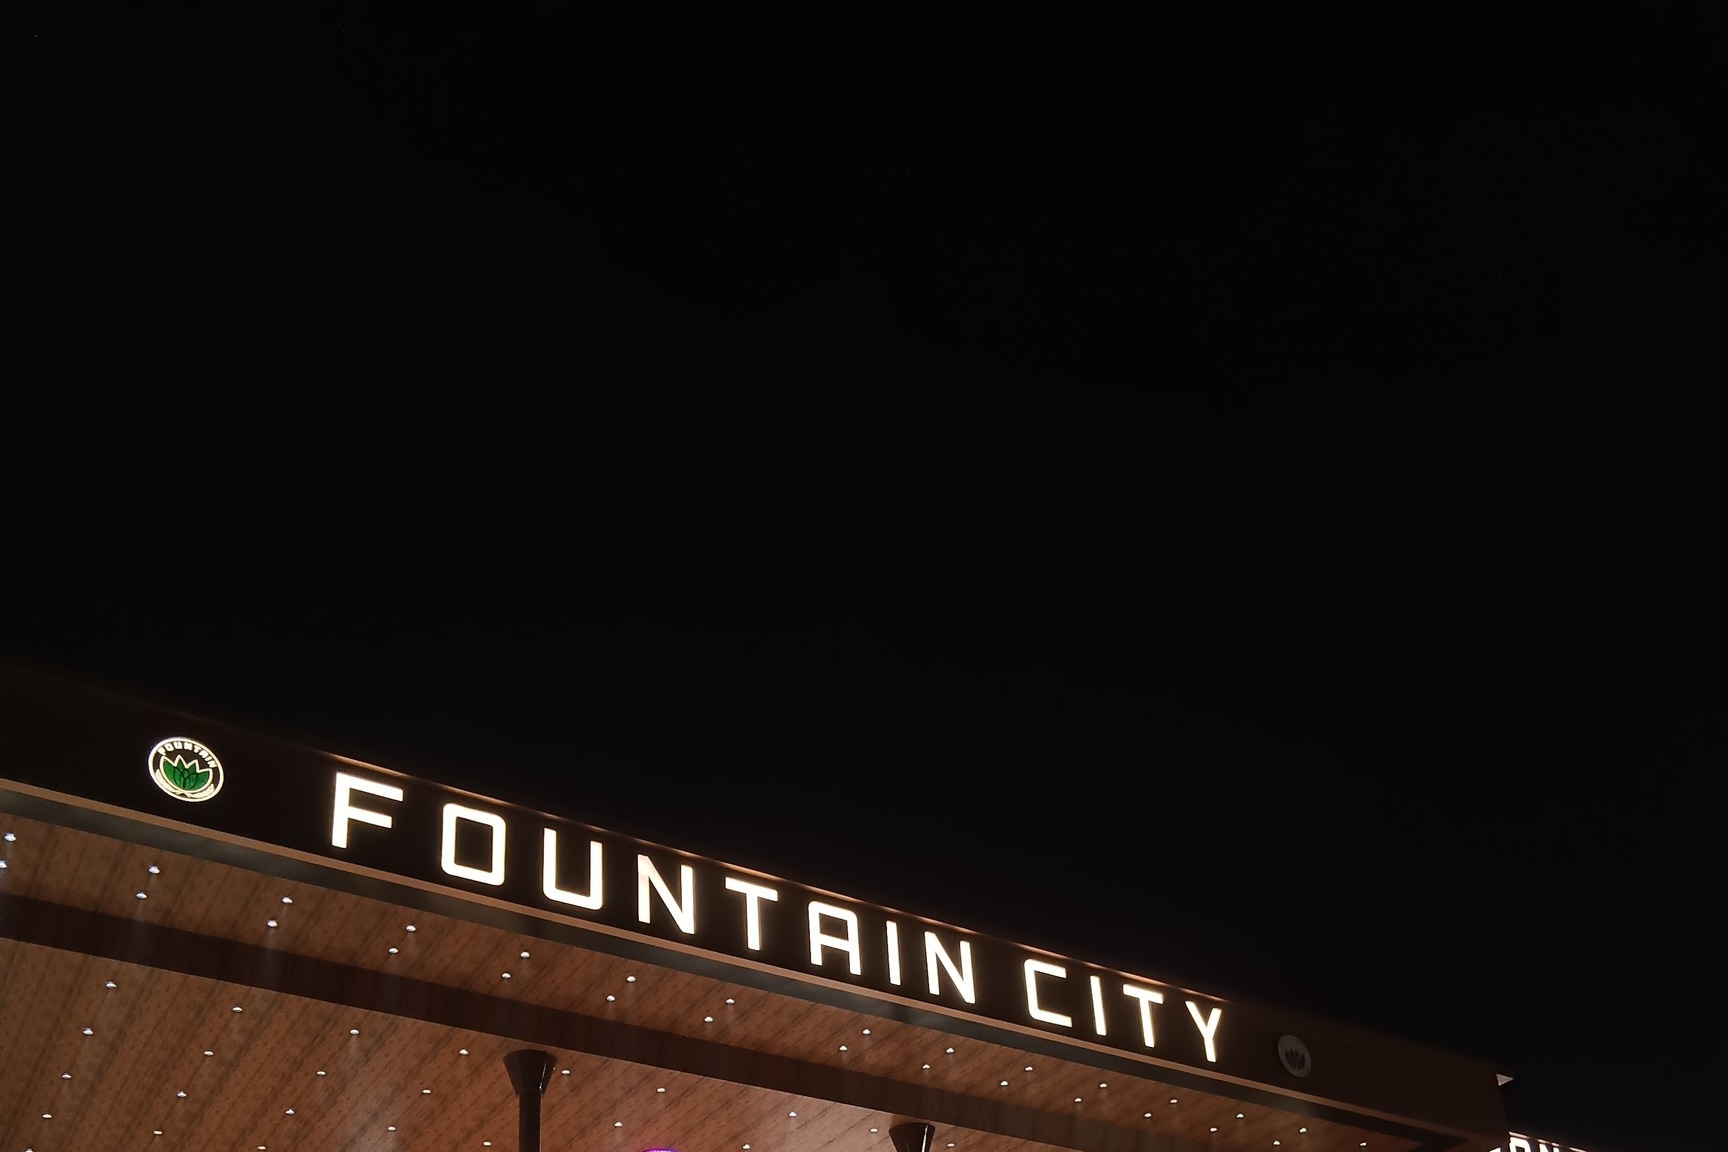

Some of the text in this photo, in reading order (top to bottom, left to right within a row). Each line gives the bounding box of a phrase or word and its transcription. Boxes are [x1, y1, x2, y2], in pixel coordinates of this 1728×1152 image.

[157, 741, 217, 768] FOUNTAIN
[332, 771, 1222, 1063] FOUNTAIN CITY
